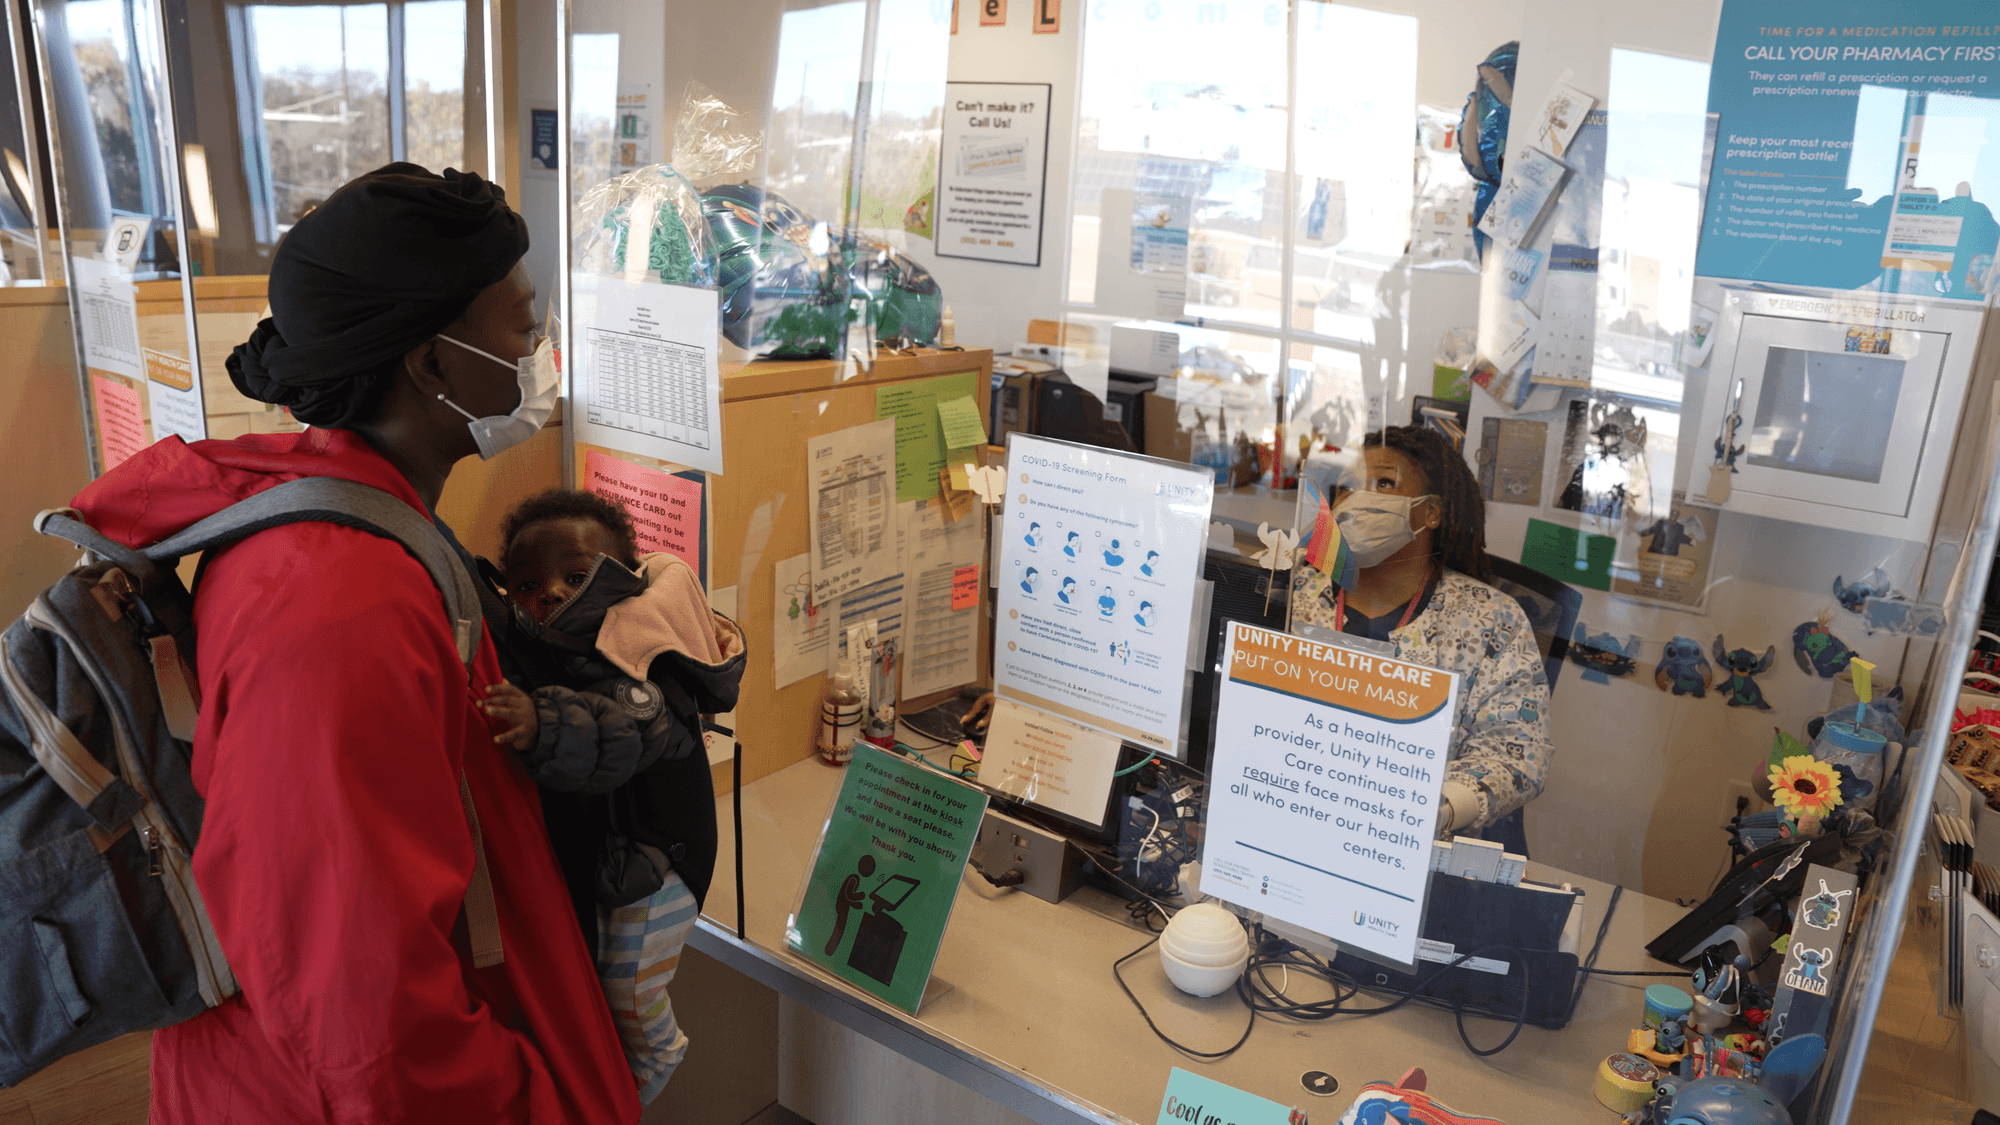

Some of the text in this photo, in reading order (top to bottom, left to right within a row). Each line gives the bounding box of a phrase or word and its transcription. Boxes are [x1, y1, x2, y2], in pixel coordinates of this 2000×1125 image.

[1759, 25, 2000, 37] TIME FOR A MEDICATION REFILL?
[1745, 46, 1785, 60] CALL
[1790, 46, 1838, 60] YOUR
[1842, 46, 1950, 61] PHARMACY
[1749, 71, 1775, 82] They
[1777, 73, 1797, 81] can
[1800, 71, 1825, 82] refill
[1839, 73, 1908, 84] prescription
[1928, 74, 1975, 84] request
[1978, 75, 1986, 83] a
[1753, 86, 1818, 96] prescription
[1821, 87, 1860, 96] renewa
[956, 101, 1034, 113] Can't make it?
[969, 117, 1011, 128] Call Us!
[1729, 134, 1855, 148] Keep your most recen
[1726, 148, 1838, 161] prescription bottle!
[1748, 183, 1795, 192] prescription
[1780, 300, 1926, 323] EMERGENCY DEFIBRILLATOR
[1022, 455, 1126, 484] COVID-19 Screening Form
[595, 472, 617, 485] Please
[620, 480, 637, 492] have
[640, 490, 657, 498] your
[671, 498, 685, 507] and
[1168, 483, 1196, 496] UNITY
[596, 487, 681, 521] INSURANCE CARD out
[634, 516, 684, 537] waiting to be
[1085, 511, 1108, 523] following
[1109, 517, 1138, 529] symptoms?
[639, 532, 660, 546] desk,
[663, 540, 685, 552] these
[1020, 621, 1038, 629] contact
[1055, 631, 1070, 640] person
[1072, 635, 1096, 646] confirmed
[1053, 622, 1068, 631] direct,
[1038, 632, 1066, 645] Coronavirus
[1074, 643, 1098, 654] COVID-19?
[1238, 627, 1432, 687] UNITY HEALTH CARE
[1054, 657, 1077, 669] diagnosed
[1079, 664, 1089, 672] with
[1090, 668, 1112, 679] COVID-19
[1147, 685, 1161, 695] days?
[1234, 650, 1419, 710] PUT ON YOUR MASK
[1305, 713, 1435, 759] As a healthcare
[1254, 724, 1431, 783] provider, Unity Health
[865, 763, 967, 810] Please check in for your
[1285, 753, 1427, 805] Care continues to
[858, 777, 963, 827] appointment at the kiosk
[1243, 765, 1424, 828] require face masks for
[857, 792, 871, 803] and
[874, 799, 893, 813] have
[903, 812, 921, 826] seat
[923, 821, 955, 840] please.
[1231, 783, 1420, 850] all who enter our health
[845, 805, 957, 862] We will be with you shortly
[871, 836, 916, 863] Thank you.
[1343, 841, 1405, 870] centers.
[1368, 915, 1399, 932] UNITY
[1787, 973, 1826, 992] OHANA
[1166, 1095, 1203, 1125] Cool
